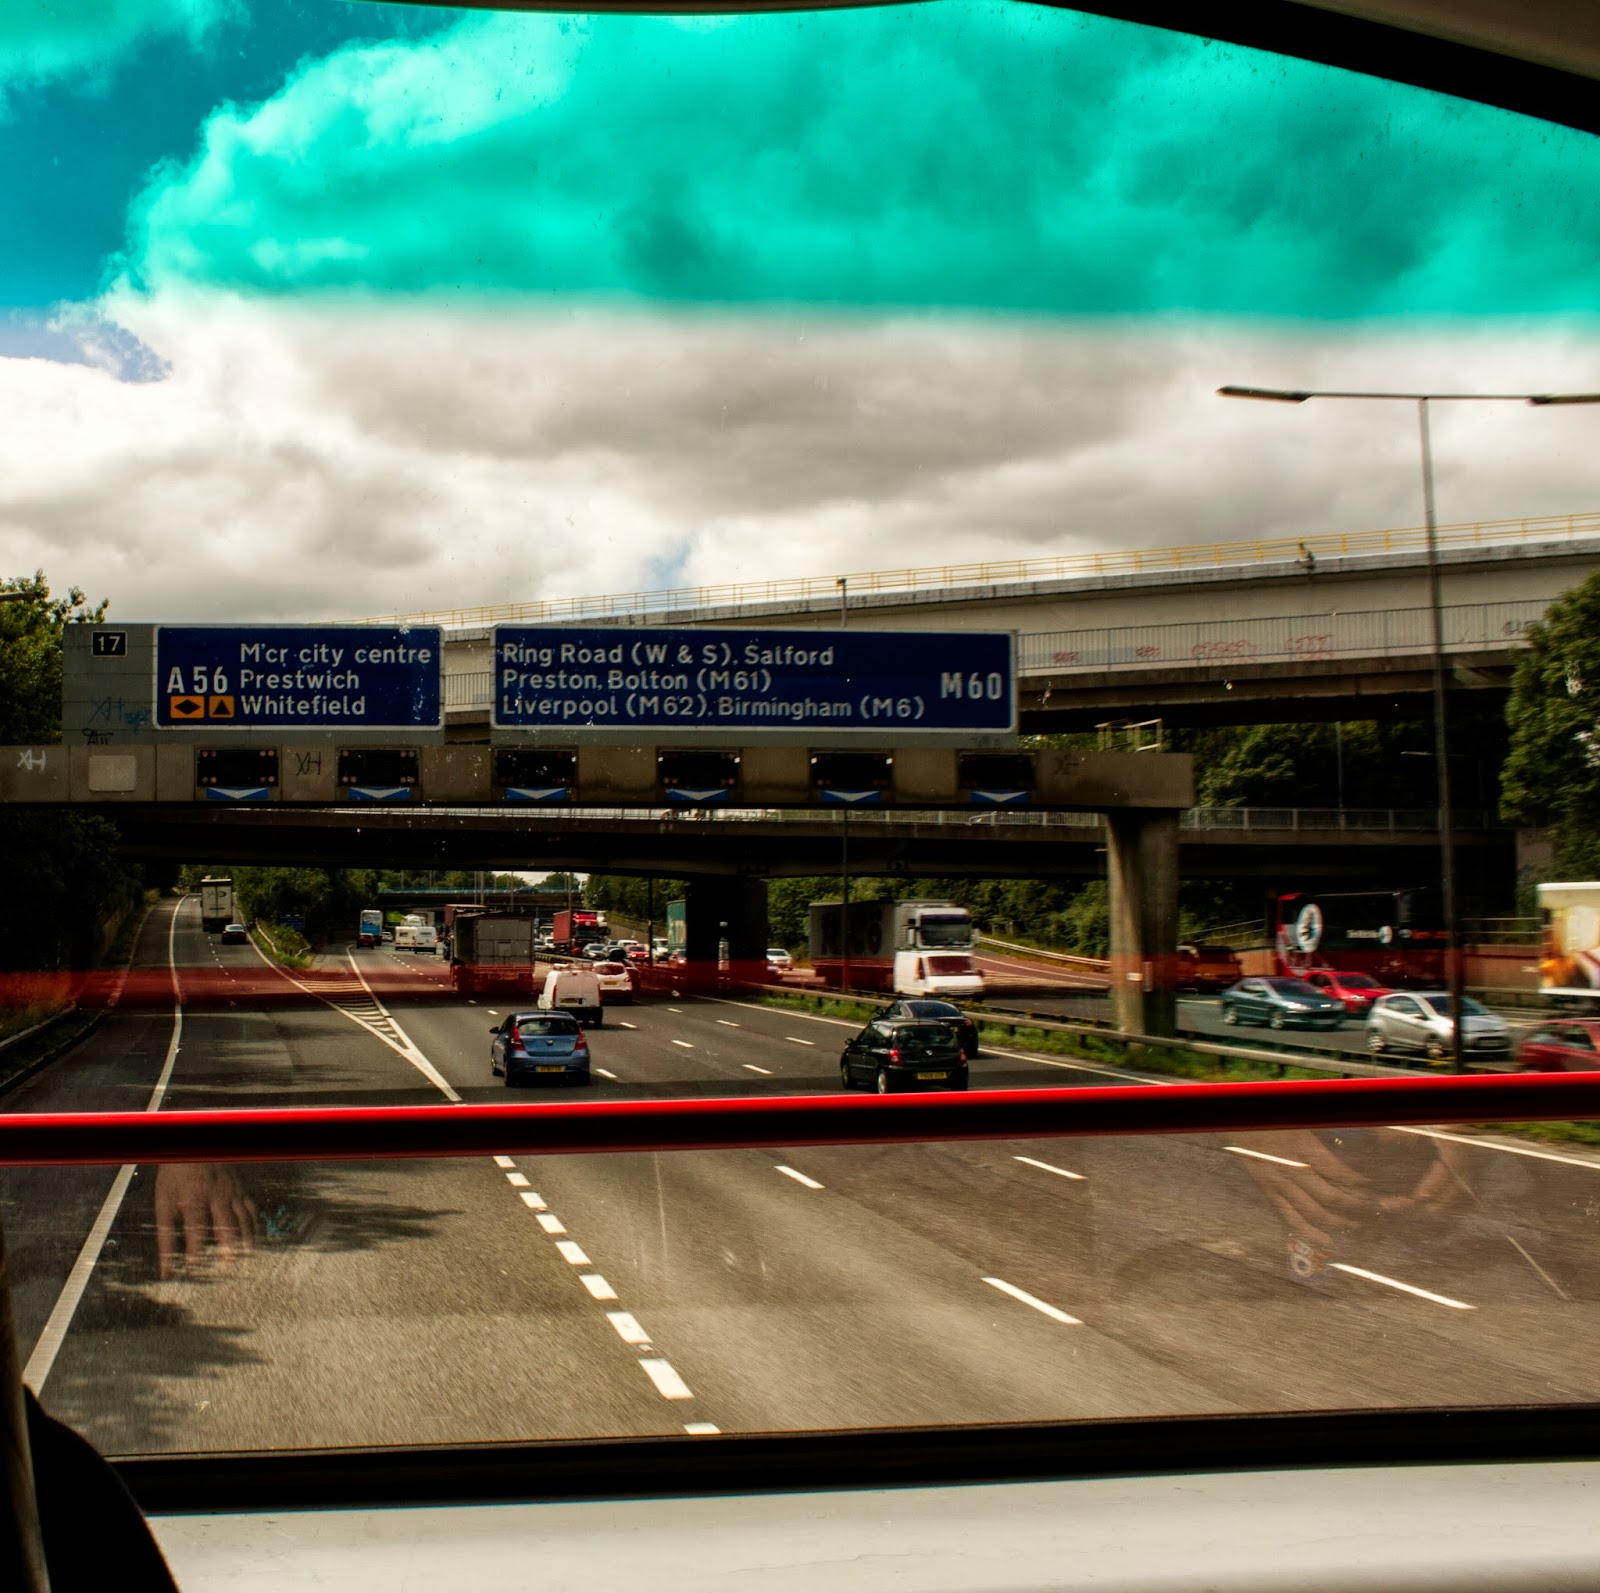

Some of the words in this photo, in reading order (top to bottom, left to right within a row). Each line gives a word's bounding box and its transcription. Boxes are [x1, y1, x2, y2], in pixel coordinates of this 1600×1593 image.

[97, 636, 121, 652] 17
[240, 643, 288, 664] M'cr
[299, 643, 344, 667] city
[354, 644, 432, 664] centre
[503, 643, 553, 668] Ring
[560, 644, 623, 664] Road
[631, 641, 668, 667] (W
[677, 644, 694, 665] &
[744, 644, 834, 666] Salford
[240, 669, 360, 690] Prestwich
[608, 669, 688, 690] Bolton
[696, 668, 772, 693] (M61)
[941, 672, 1003, 700] M60
[240, 695, 366, 716] Whitefield
[503, 695, 618, 719] Liverpool
[718, 697, 852, 720] Birmingham
[860, 695, 925, 719] (M6)
